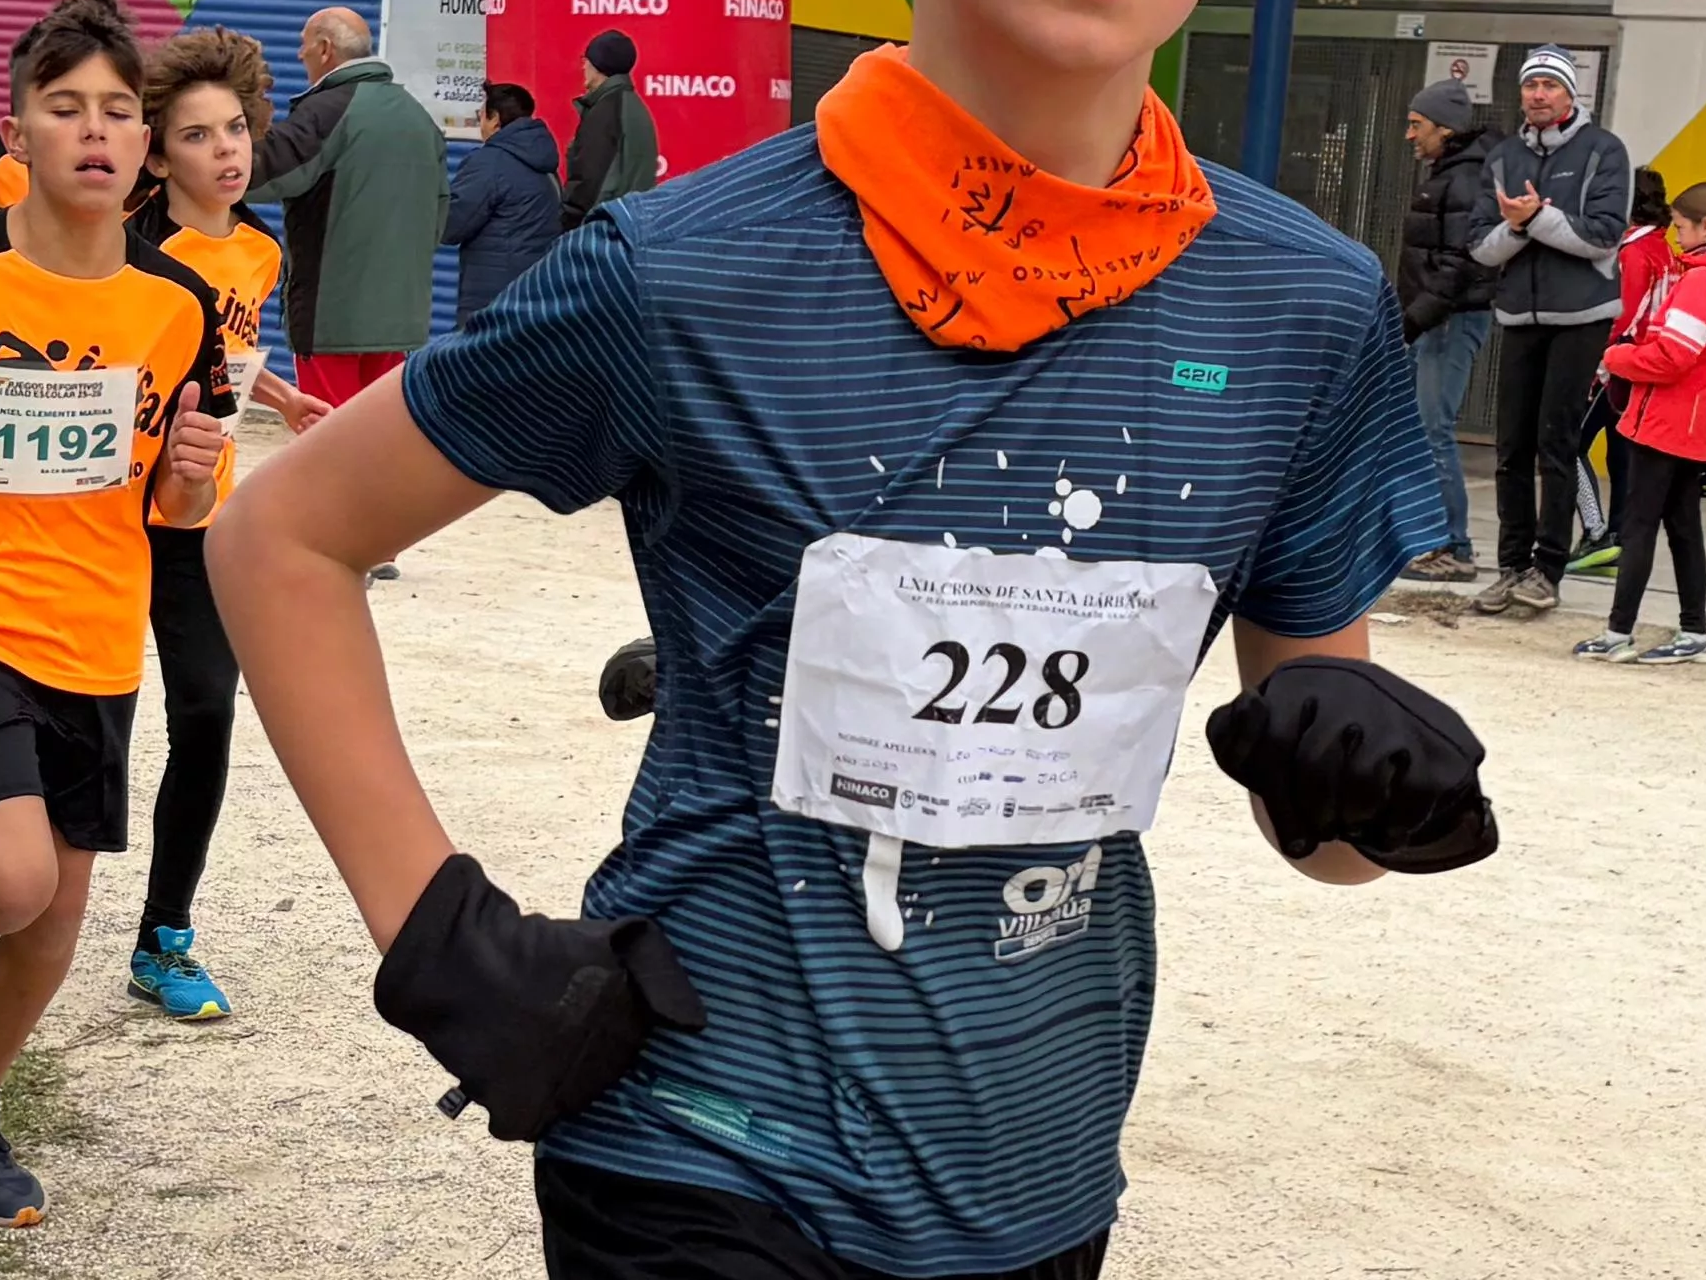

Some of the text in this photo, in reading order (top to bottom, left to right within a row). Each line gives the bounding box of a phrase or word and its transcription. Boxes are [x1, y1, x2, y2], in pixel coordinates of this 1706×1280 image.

[645, 75, 736, 97] HINACO
[25, 409, 76, 418] CLEMENTE
[940, 581, 992, 598] CROSS
[995, 585, 1019, 600] DE
[1022, 587, 1077, 606] SANTA
[911, 640, 1090, 730] 228
[836, 778, 890, 799] HINACO
